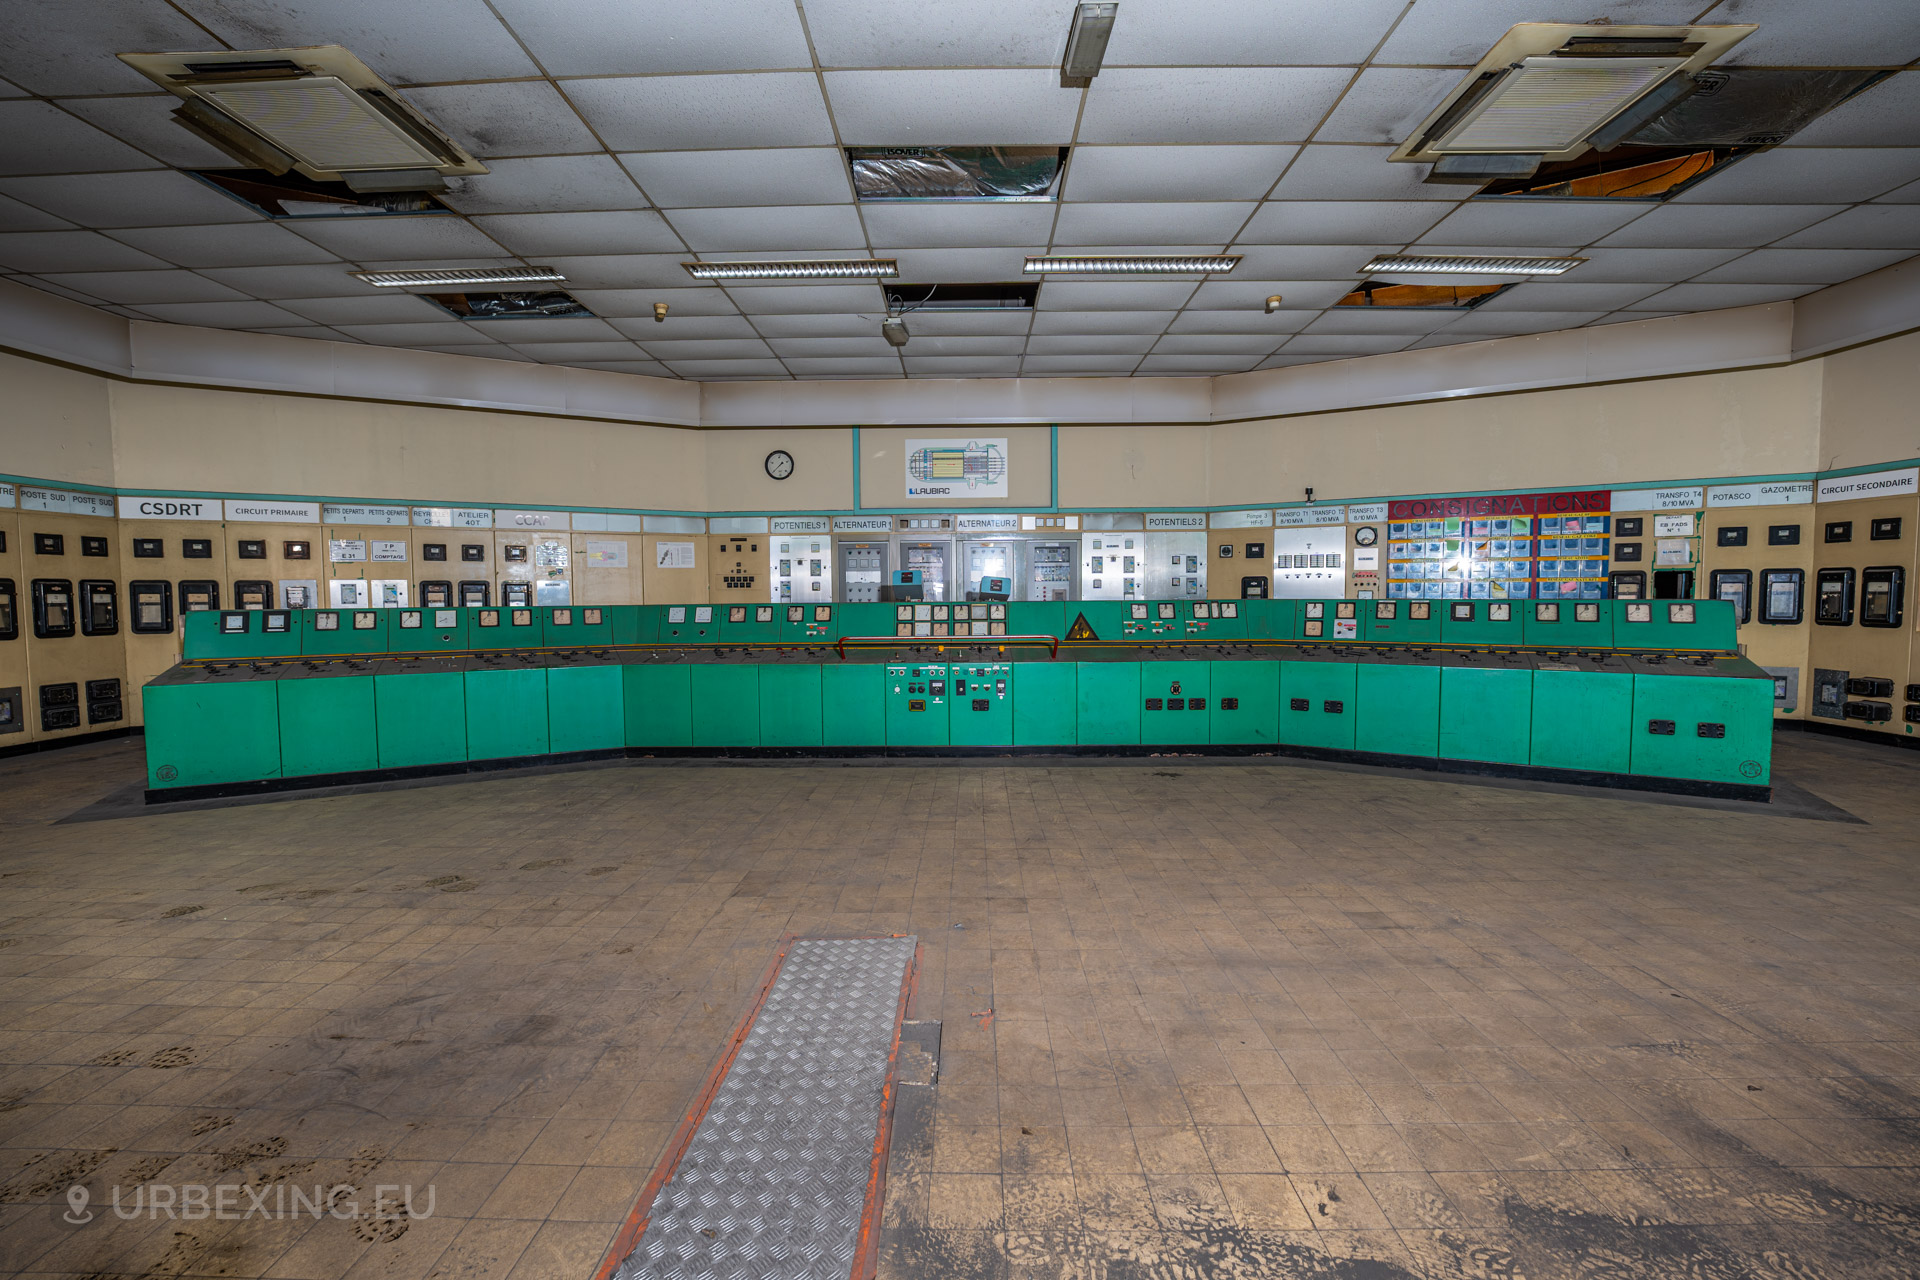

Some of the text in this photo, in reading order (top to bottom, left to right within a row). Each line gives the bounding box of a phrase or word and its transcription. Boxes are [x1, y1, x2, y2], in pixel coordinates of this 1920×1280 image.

[1761, 485, 1814, 494] GAZOMETRE
[1821, 478, 1912, 494] CIRCUIT SECONDAIRE
[20, 490, 66, 502] POSTE SUD
[72, 496, 113, 506] POSTE SUD
[1712, 493, 1751, 501] POTASCO
[140, 502, 203, 516] CSDRT
[1393, 493, 1605, 517] CONSIGNATIONS
[235, 507, 309, 517] CIRCUIT PRIMAIRE
